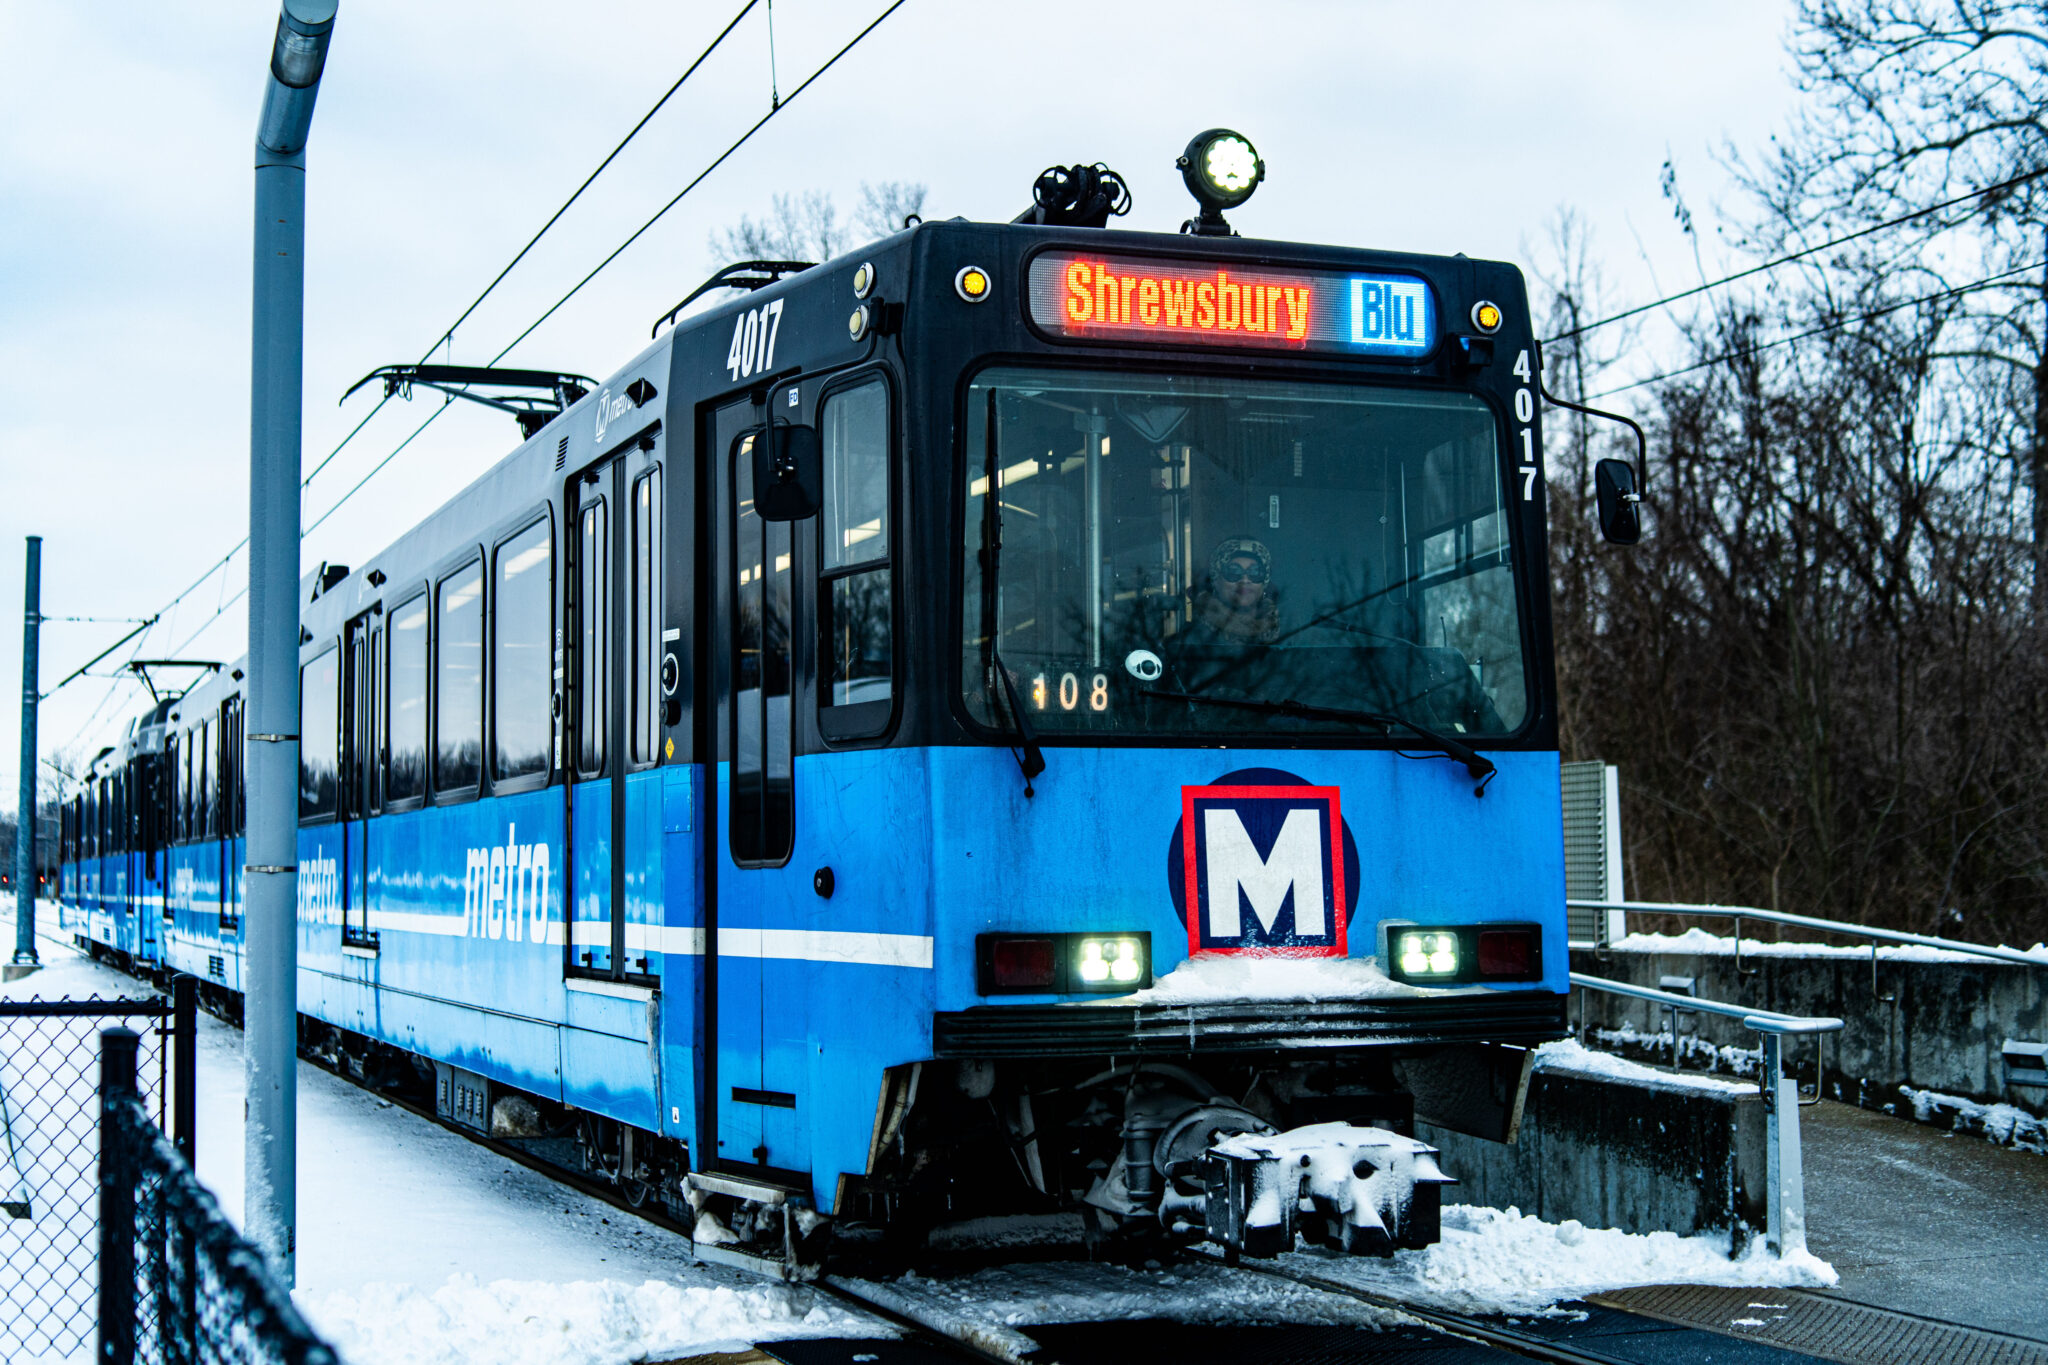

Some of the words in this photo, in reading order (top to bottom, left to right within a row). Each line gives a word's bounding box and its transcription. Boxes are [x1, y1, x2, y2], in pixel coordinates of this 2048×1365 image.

[726, 297, 784, 382] 4017
[1066, 262, 1310, 340] Shrewsbury
[1362, 282, 1414, 340] Blu
[789, 392, 798, 403] FD
[1512, 349, 1537, 501] 4017
[1032, 672, 1108, 711] 108
[296, 843, 337, 924] metro
[465, 822, 550, 944] metro
[1204, 809, 1326, 937] M
